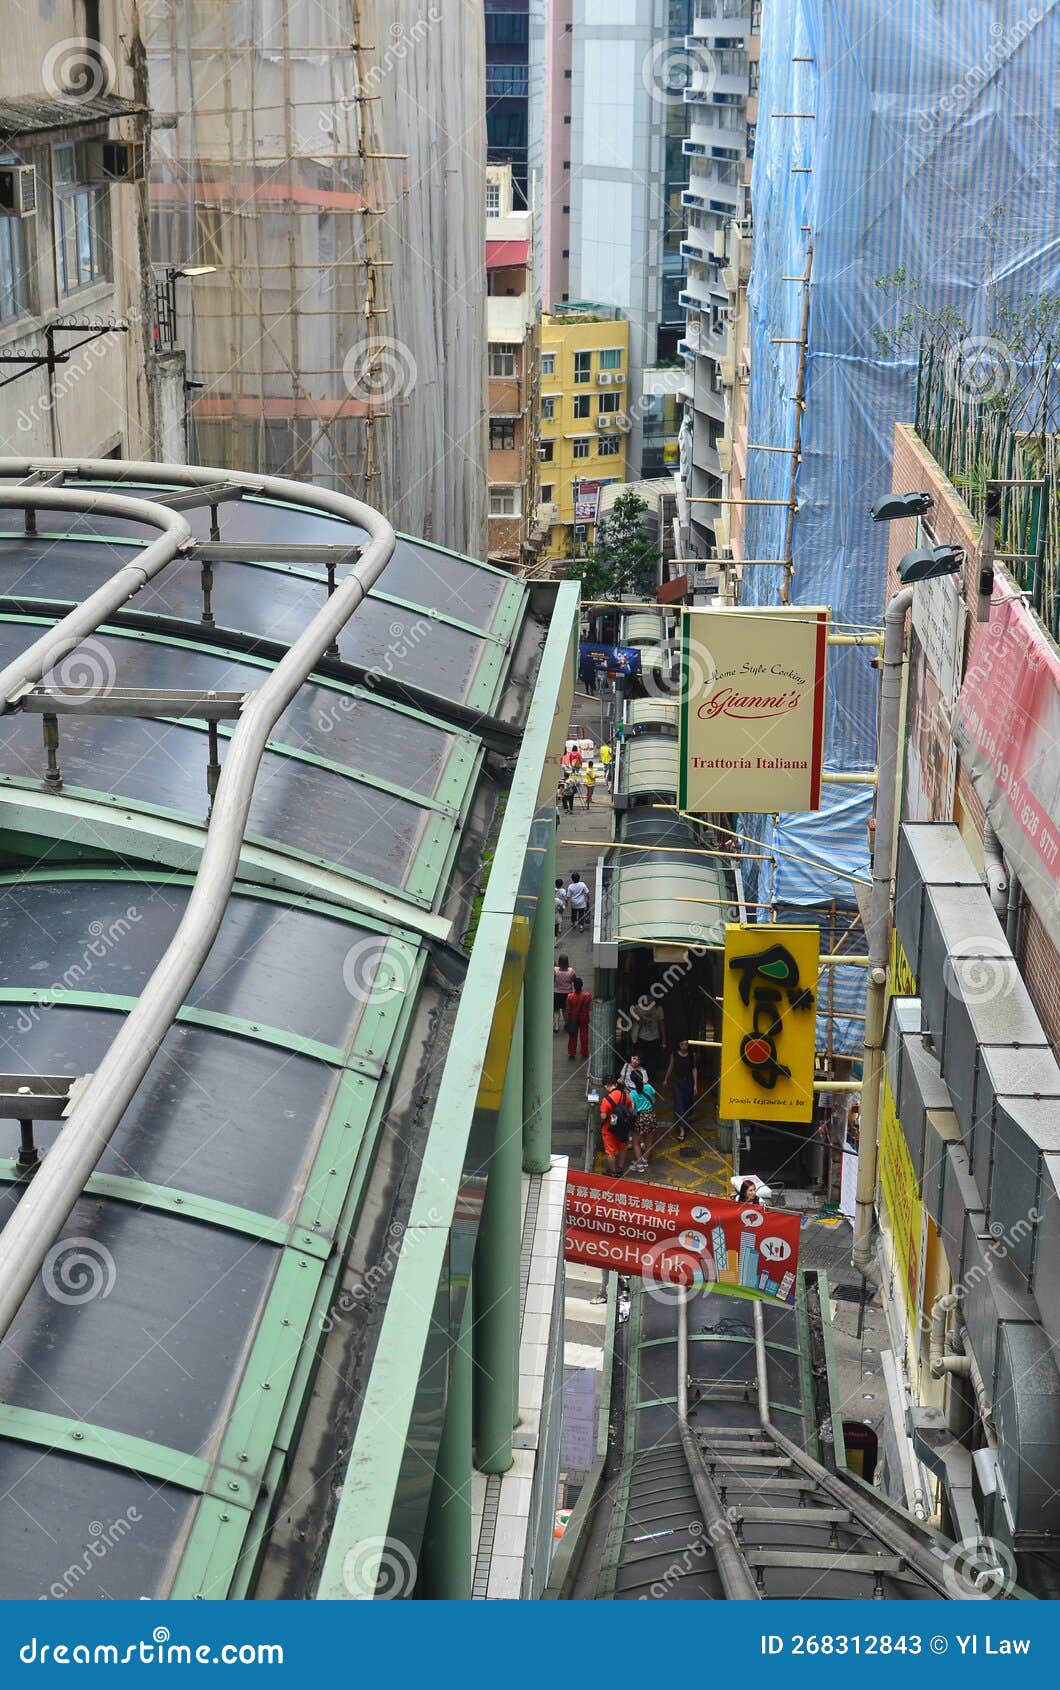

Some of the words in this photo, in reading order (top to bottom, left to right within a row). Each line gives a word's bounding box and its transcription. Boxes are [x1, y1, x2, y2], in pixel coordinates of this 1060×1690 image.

[740, 662, 767, 676] Style
[770, 664, 808, 685] Cooking
[697, 688, 802, 719] Gianni's
[691, 757, 751, 769] Trattoria
[756, 757, 808, 769] Italiana
[574, 1200, 591, 1214] TO
[595, 1205, 676, 1231] EVERYTHING
[619, 1225, 657, 1241] SOHO
